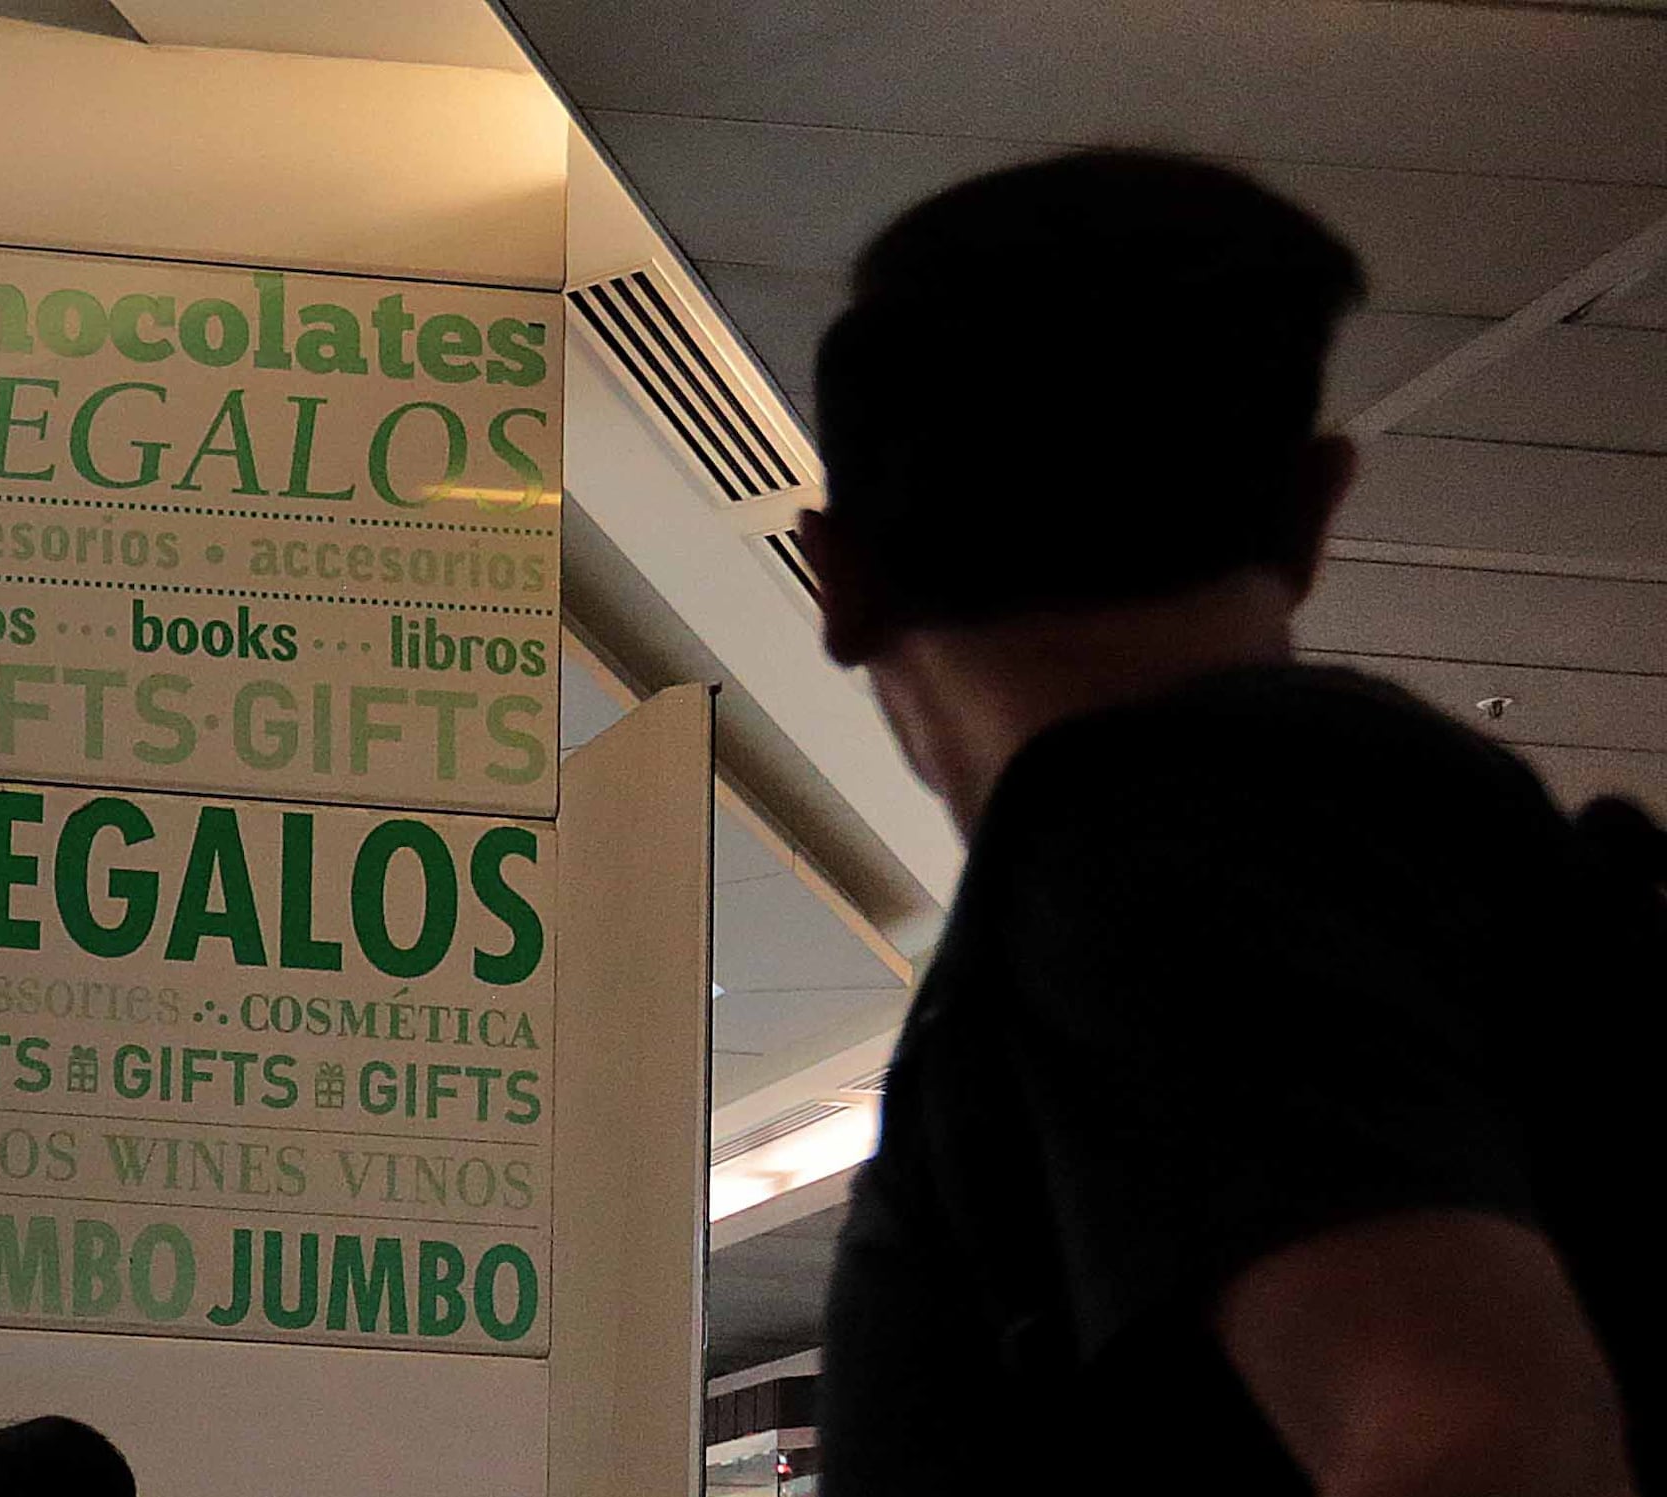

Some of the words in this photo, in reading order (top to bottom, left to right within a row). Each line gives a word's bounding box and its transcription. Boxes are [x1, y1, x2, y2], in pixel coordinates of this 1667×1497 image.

[249, 532, 545, 593] accesorios
[132, 600, 298, 661] books
[390, 616, 547, 677] libros
[232, 678, 546, 785] GIFTS
[240, 988, 538, 1050] COSMÉTICA
[112, 1044, 299, 1110] GIFTS
[358, 1061, 542, 1125] GIFTS
[101, 1134, 307, 1199] WINES
[338, 1150, 534, 1211] VINOS
[207, 1228, 538, 1342] JUMBO
